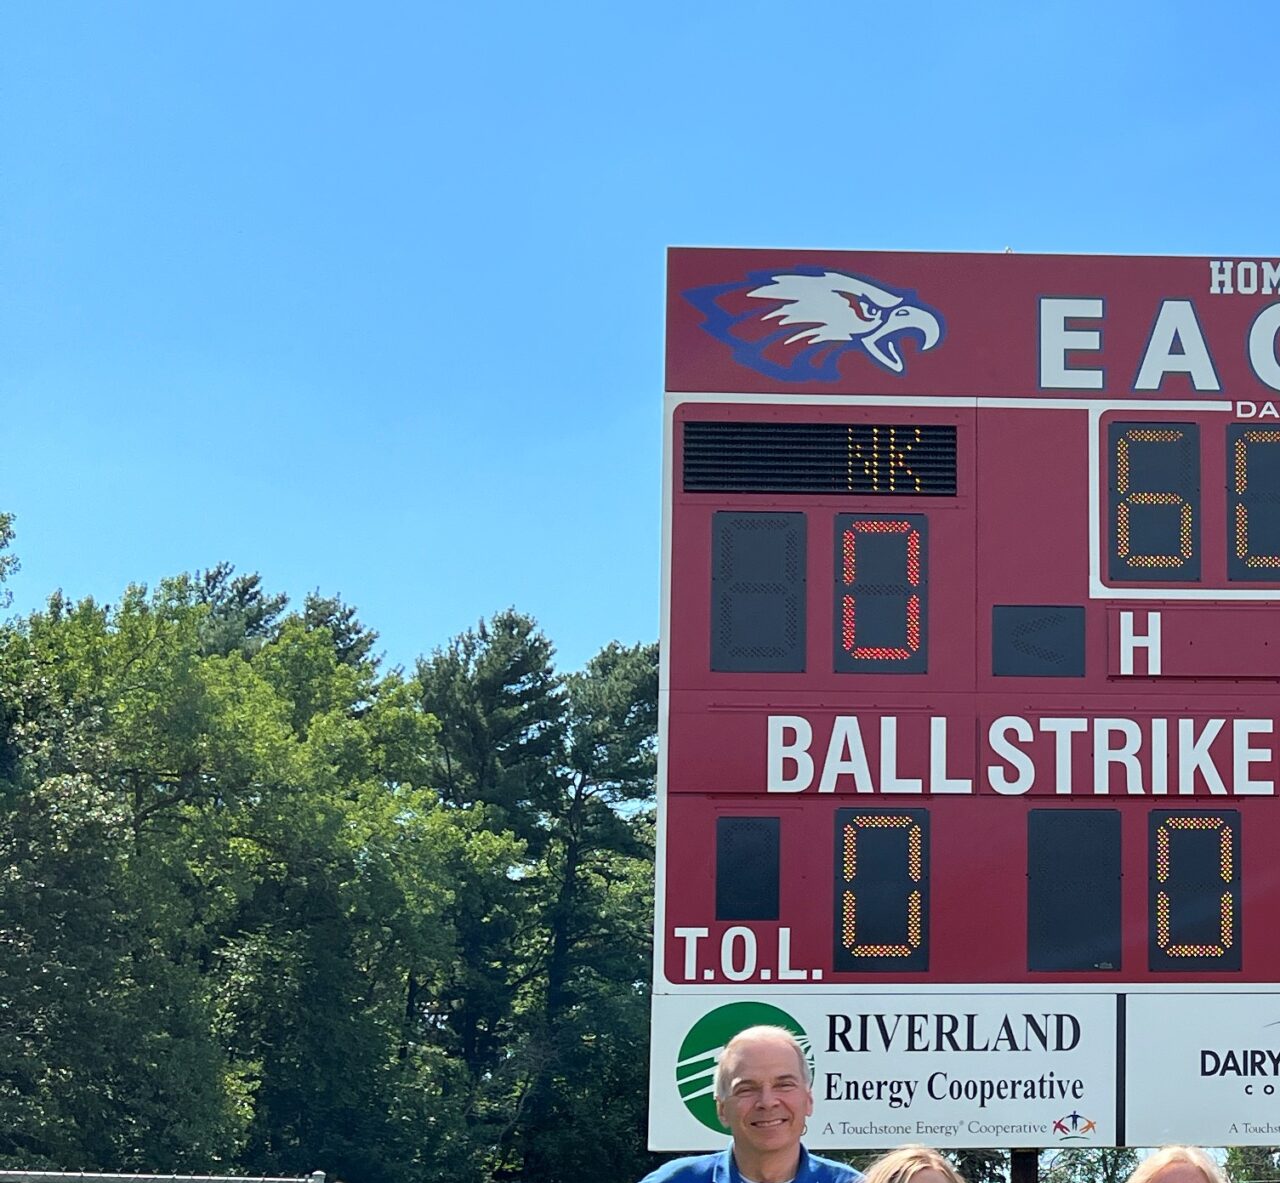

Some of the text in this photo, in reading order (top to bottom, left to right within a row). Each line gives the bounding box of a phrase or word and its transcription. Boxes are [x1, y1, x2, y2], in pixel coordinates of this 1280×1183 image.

[842, 520, 922, 660] 0
[1119, 611, 1162, 676] H
[766, 715, 973, 794] BALL
[986, 717, 1275, 796] STRIKE
[842, 815, 922, 957] 0
[1156, 816, 1234, 957] 0
[674, 926, 824, 981] T.O.L.
[824, 1013, 1082, 1053] RIVERLAND
[823, 1071, 1084, 1109] Energy Cooperative
[822, 1122, 835, 1136] A
[839, 1121, 913, 1136] Touchstone
[967, 1120, 1048, 1137] Cooperative
[1228, 1122, 1239, 1134] A
